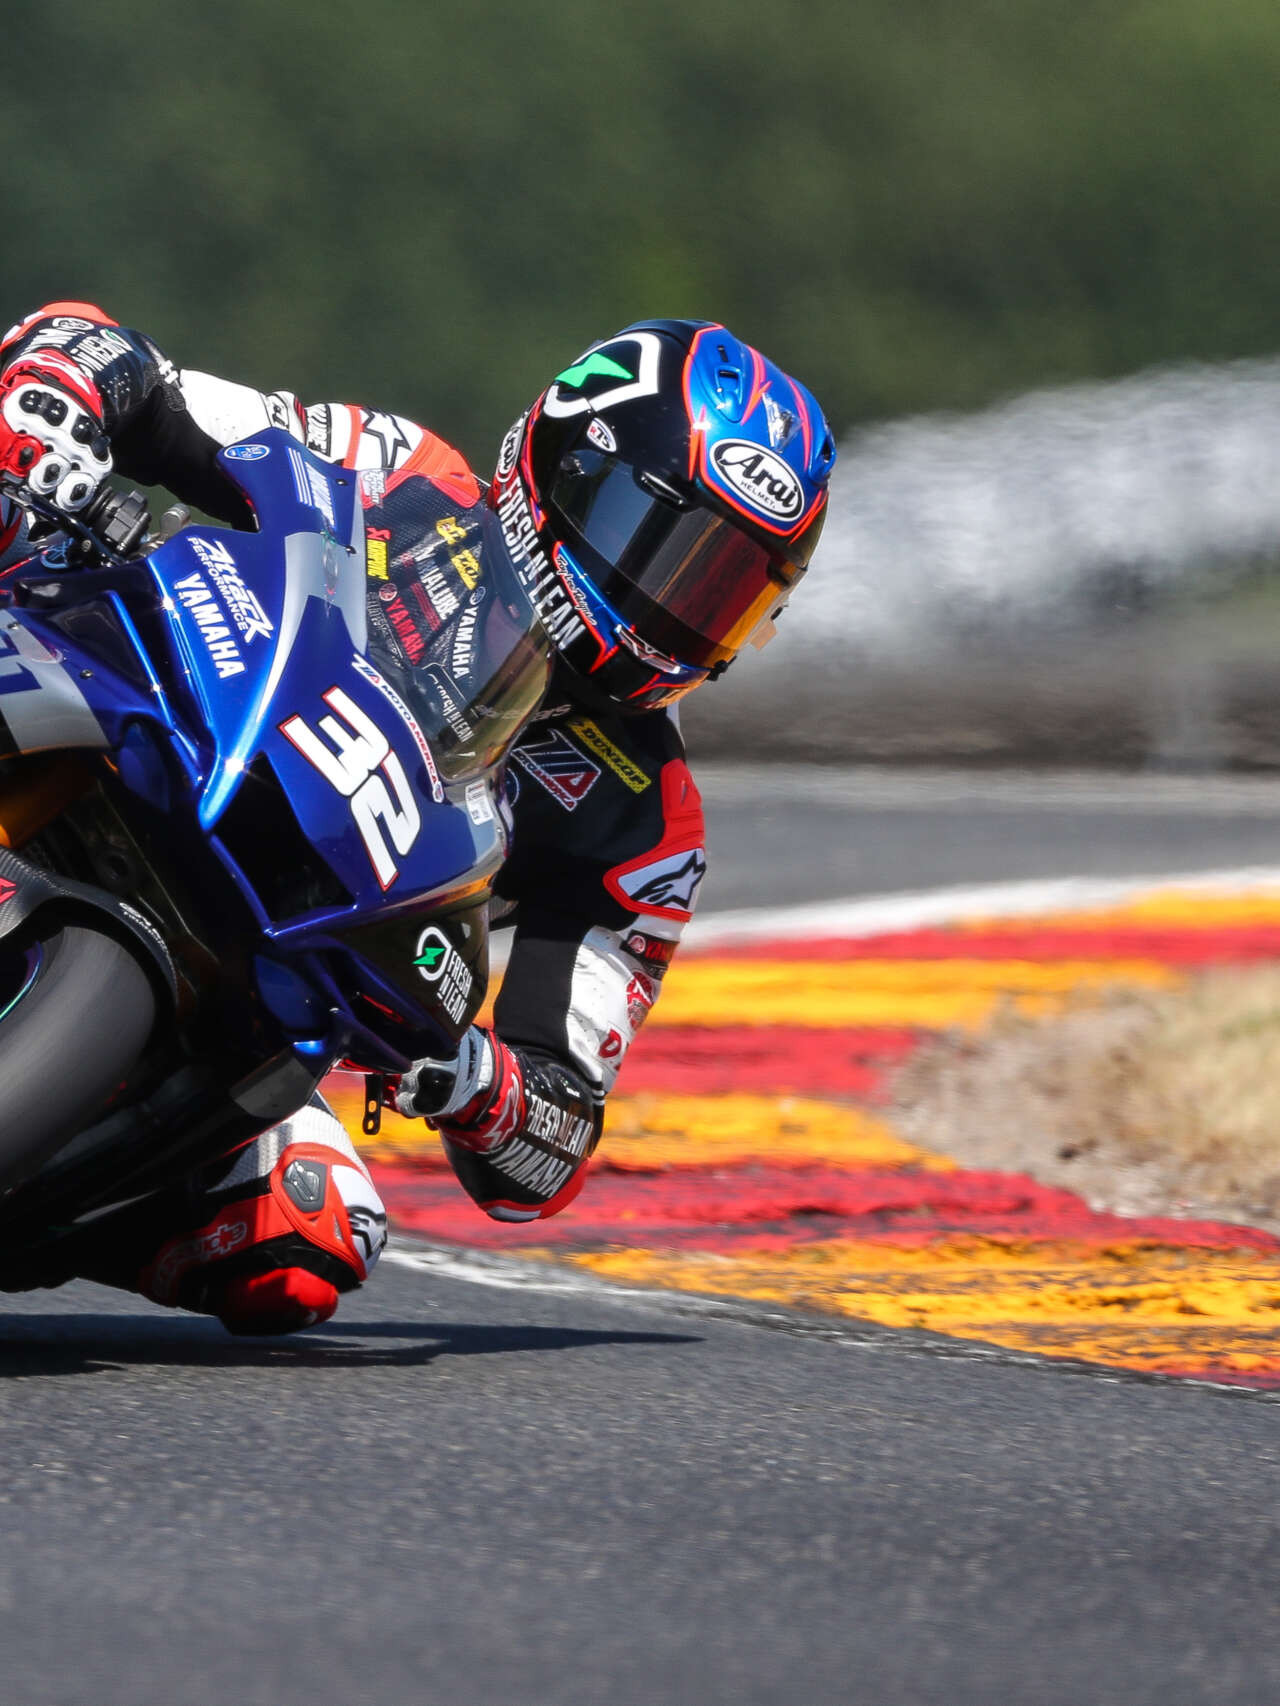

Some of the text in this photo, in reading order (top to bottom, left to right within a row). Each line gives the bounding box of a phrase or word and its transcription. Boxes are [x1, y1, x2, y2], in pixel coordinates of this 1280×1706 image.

[719, 452, 801, 508] Arai
[187, 537, 248, 631] PERFORMANCE
[198, 539, 274, 644] Attack
[498, 476, 539, 563] FRESH
[528, 572, 586, 650] LEAN
[174, 573, 246, 679] YAMAHA
[386, 597, 426, 665] YAMAHA
[452, 606, 478, 680] YAMAHA
[381, 684, 439, 784] MOTOAMERICA
[280, 686, 421, 891] 32
[443, 982, 468, 1025] LEAN
[447, 950, 473, 999] FRESH
[527, 1094, 561, 1144] FRESH
[488, 1136, 573, 1199] YAMAHA
